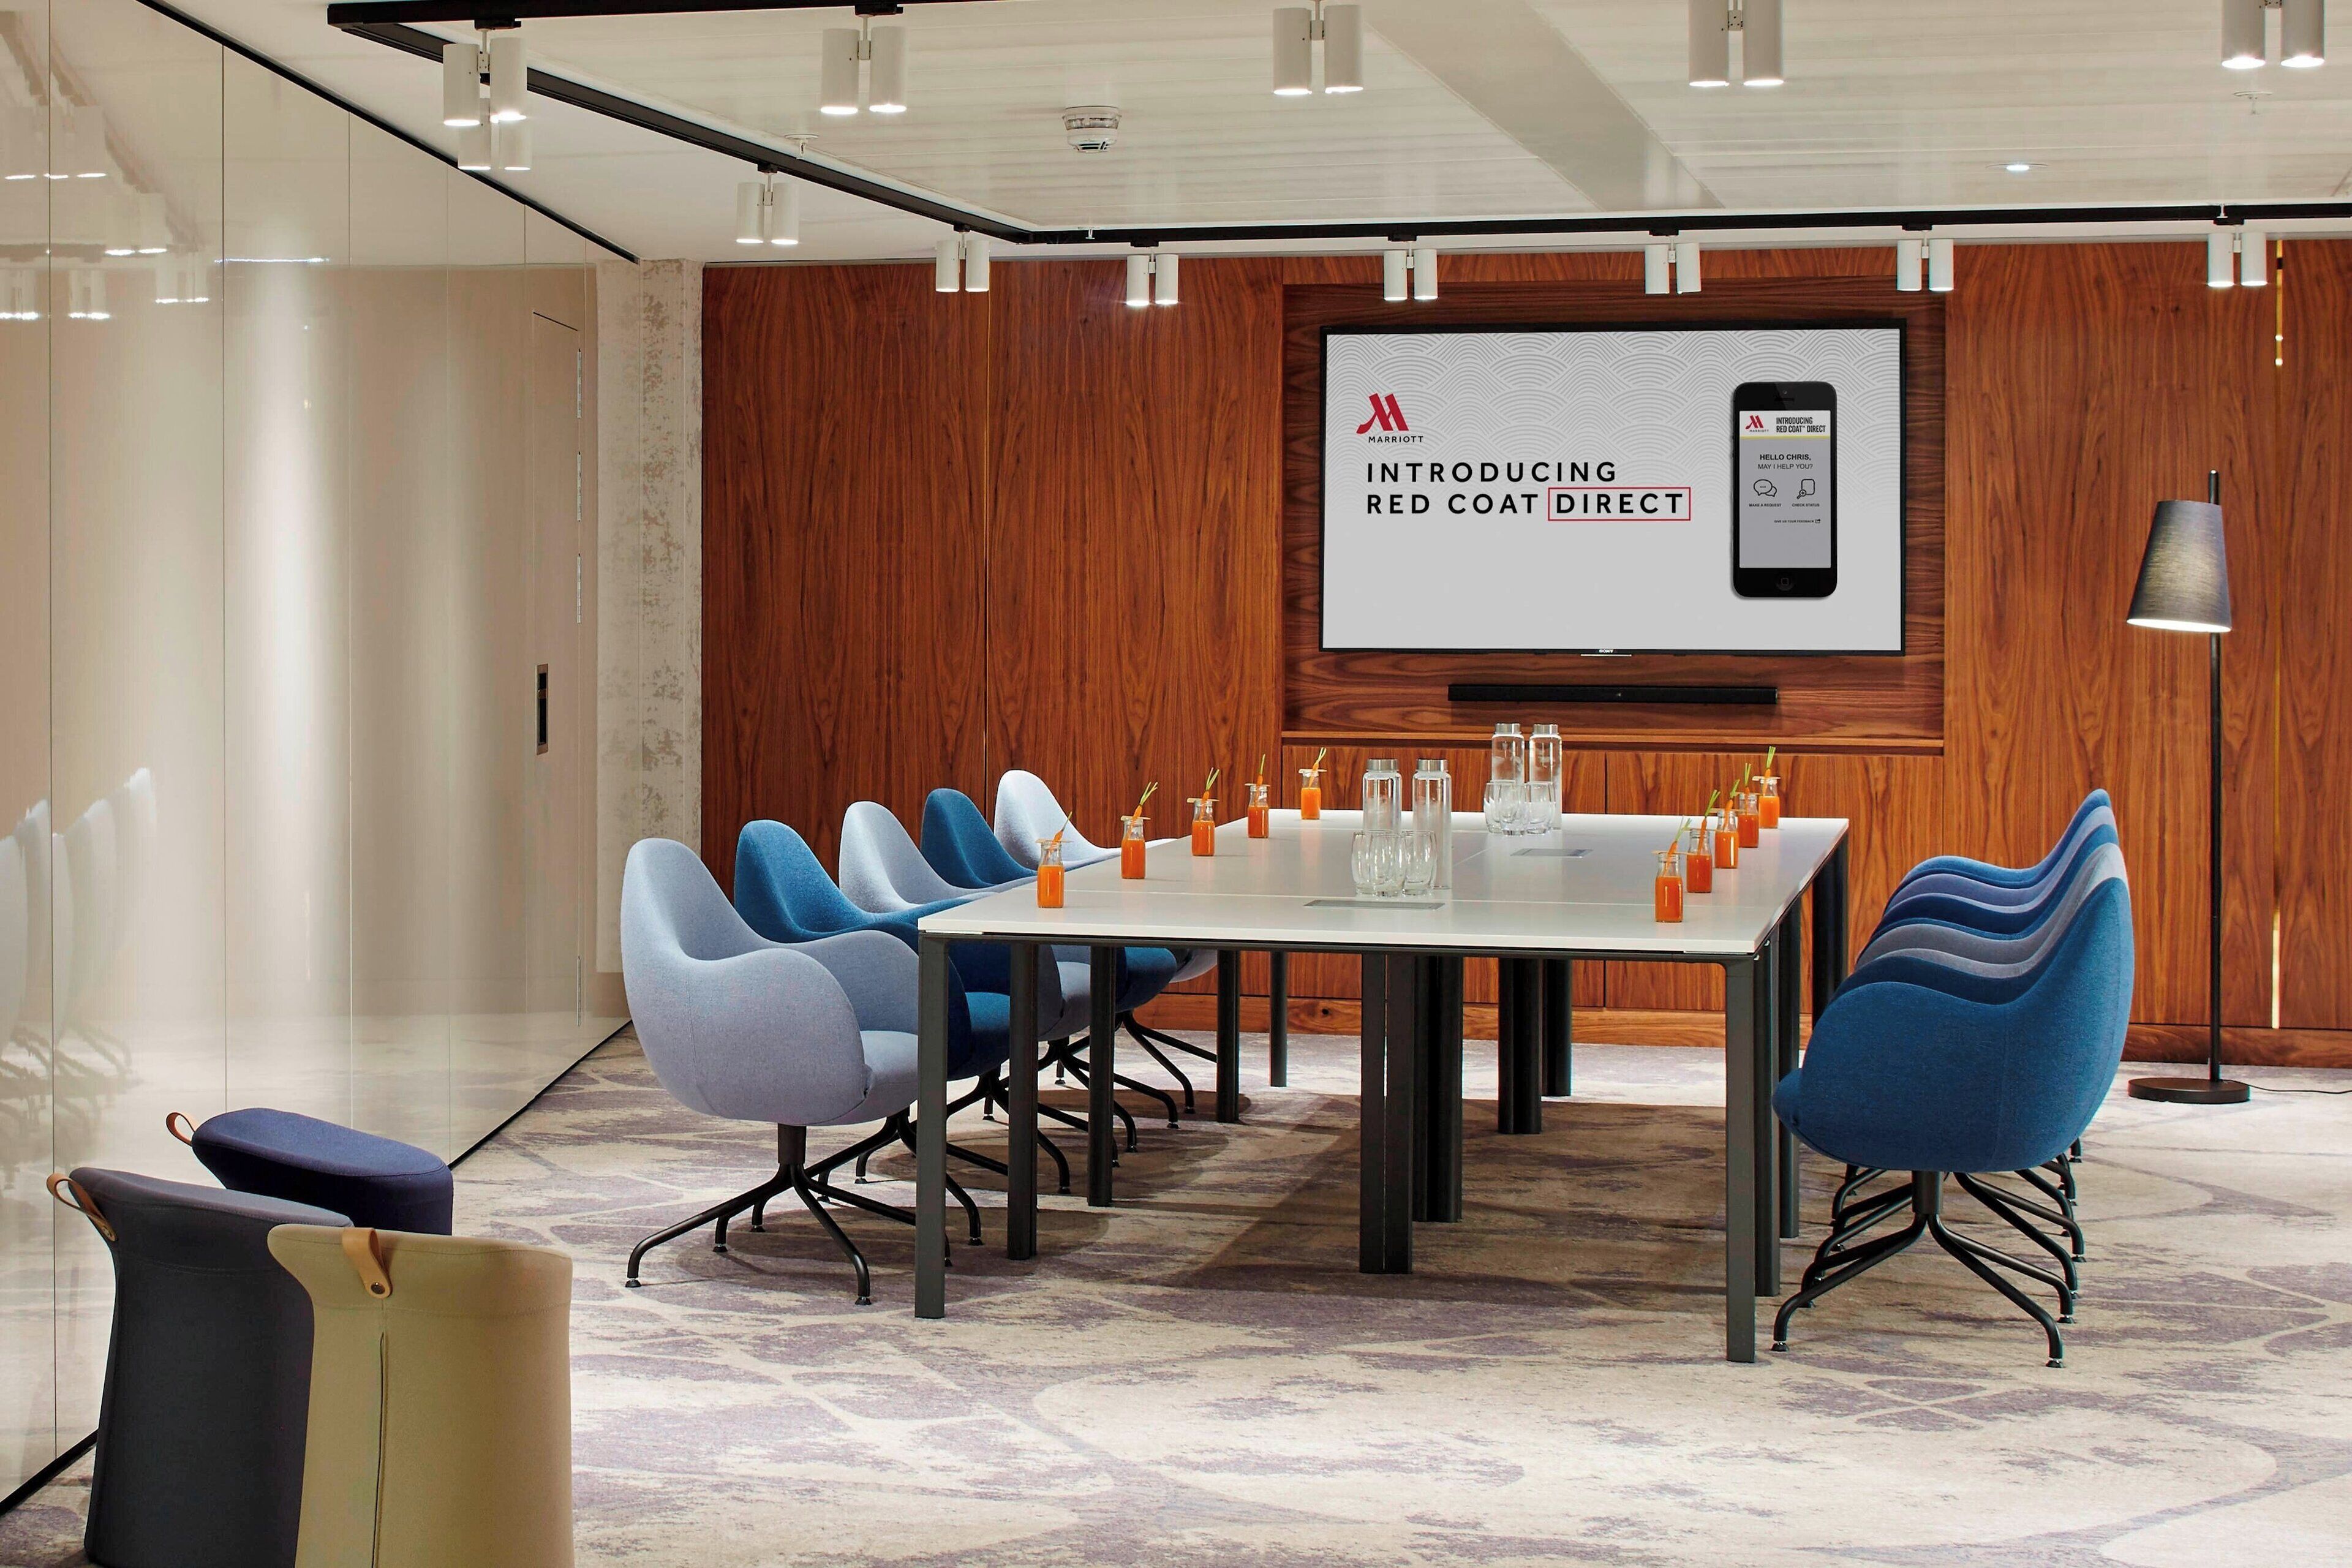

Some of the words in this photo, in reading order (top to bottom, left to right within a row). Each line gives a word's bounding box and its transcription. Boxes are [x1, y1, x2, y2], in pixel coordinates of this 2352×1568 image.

[1367, 461, 1616, 483] INTRODUCING
[1367, 494, 1430, 514] RED
[1448, 494, 1538, 514] COAT
[1556, 493, 1683, 514] DIRECT
